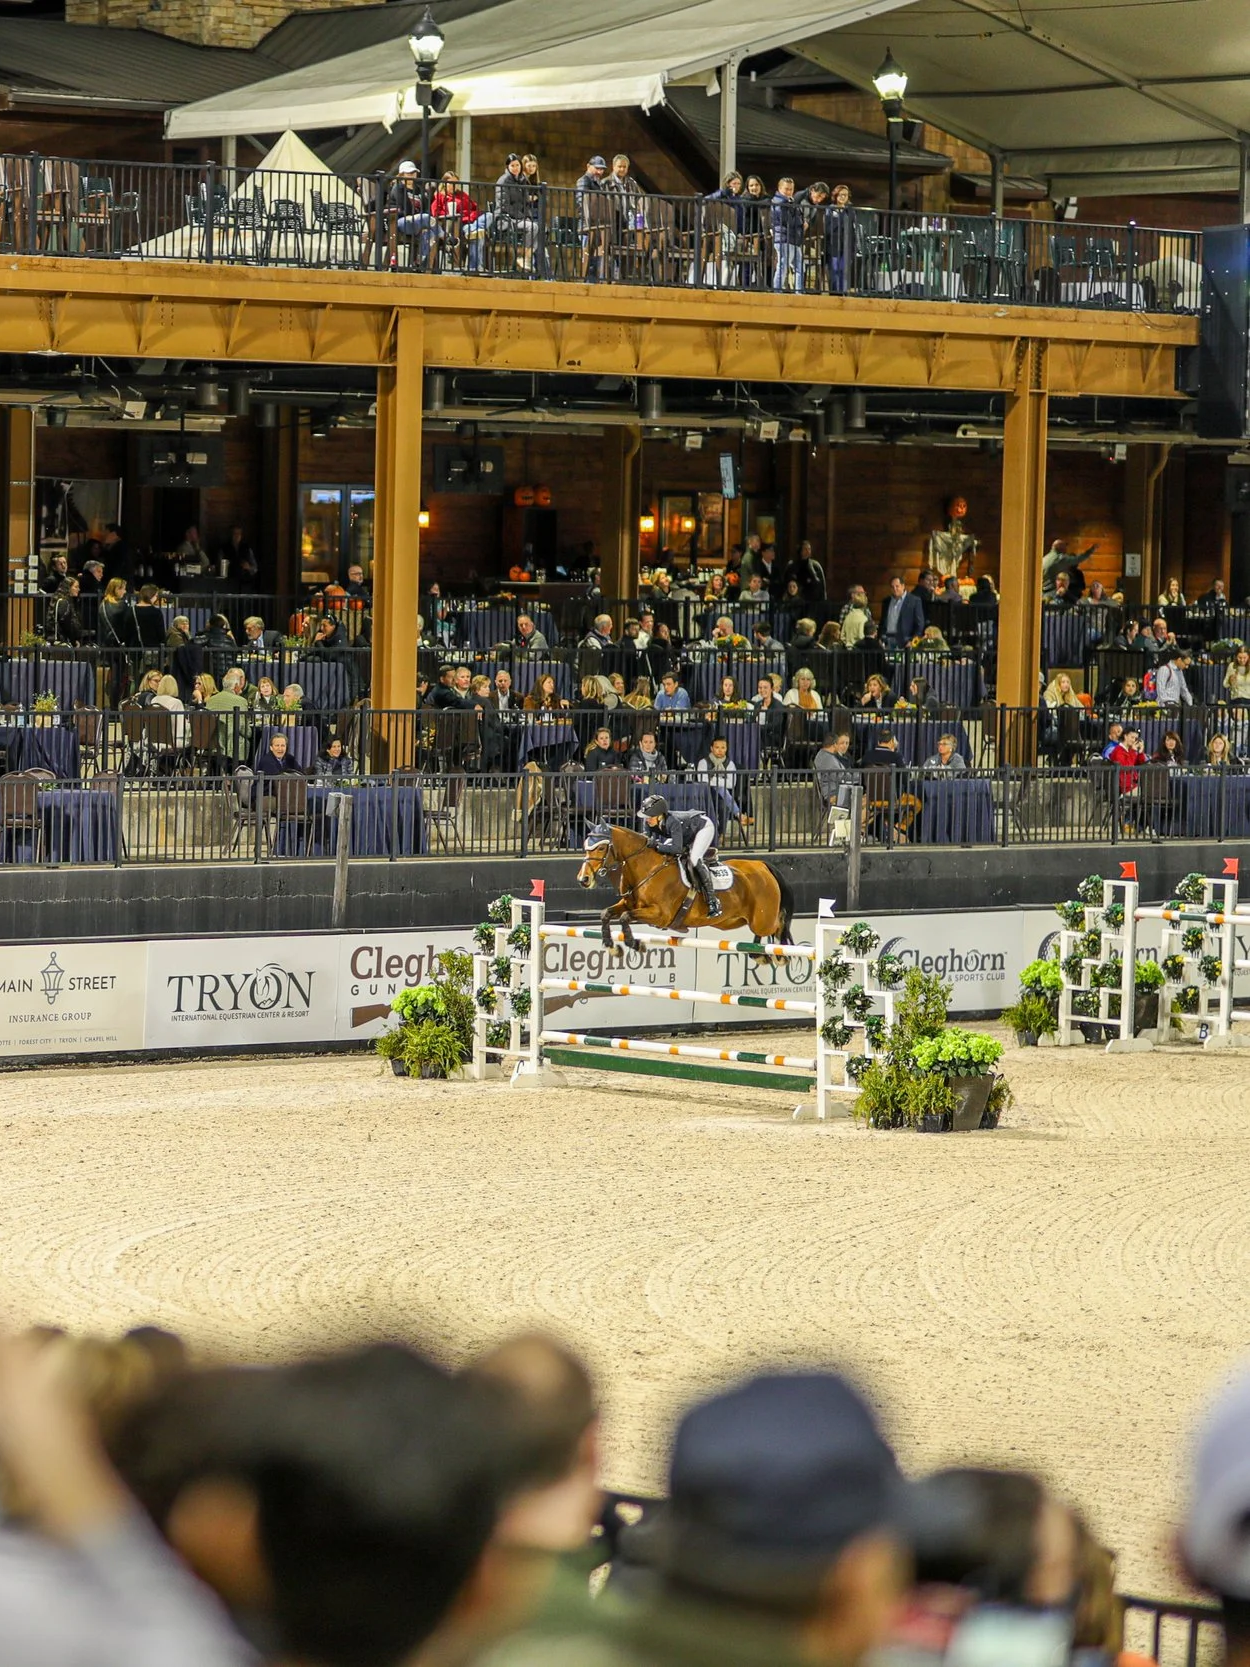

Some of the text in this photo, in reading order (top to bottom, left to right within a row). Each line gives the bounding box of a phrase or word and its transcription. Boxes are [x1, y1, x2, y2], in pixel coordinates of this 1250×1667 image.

[717, 943, 816, 987] TRYO
[68, 976, 117, 990] STREET
[608, 972, 676, 985] CLUB
[955, 973, 984, 982] SPORTS
[986, 972, 1006, 980] CLUB
[167, 963, 316, 1012] TRYON
[350, 984, 396, 996] GUN
[8, 1012, 92, 1023] INSURANCE GROUP
[171, 1013, 217, 1021] INTERNATIONAL
[219, 1012, 256, 1021] EQUESTRIAN
[257, 1011, 280, 1019] CENTER
[287, 1010, 309, 1018] RESORT
[1199, 1023, 1209, 1039] B
